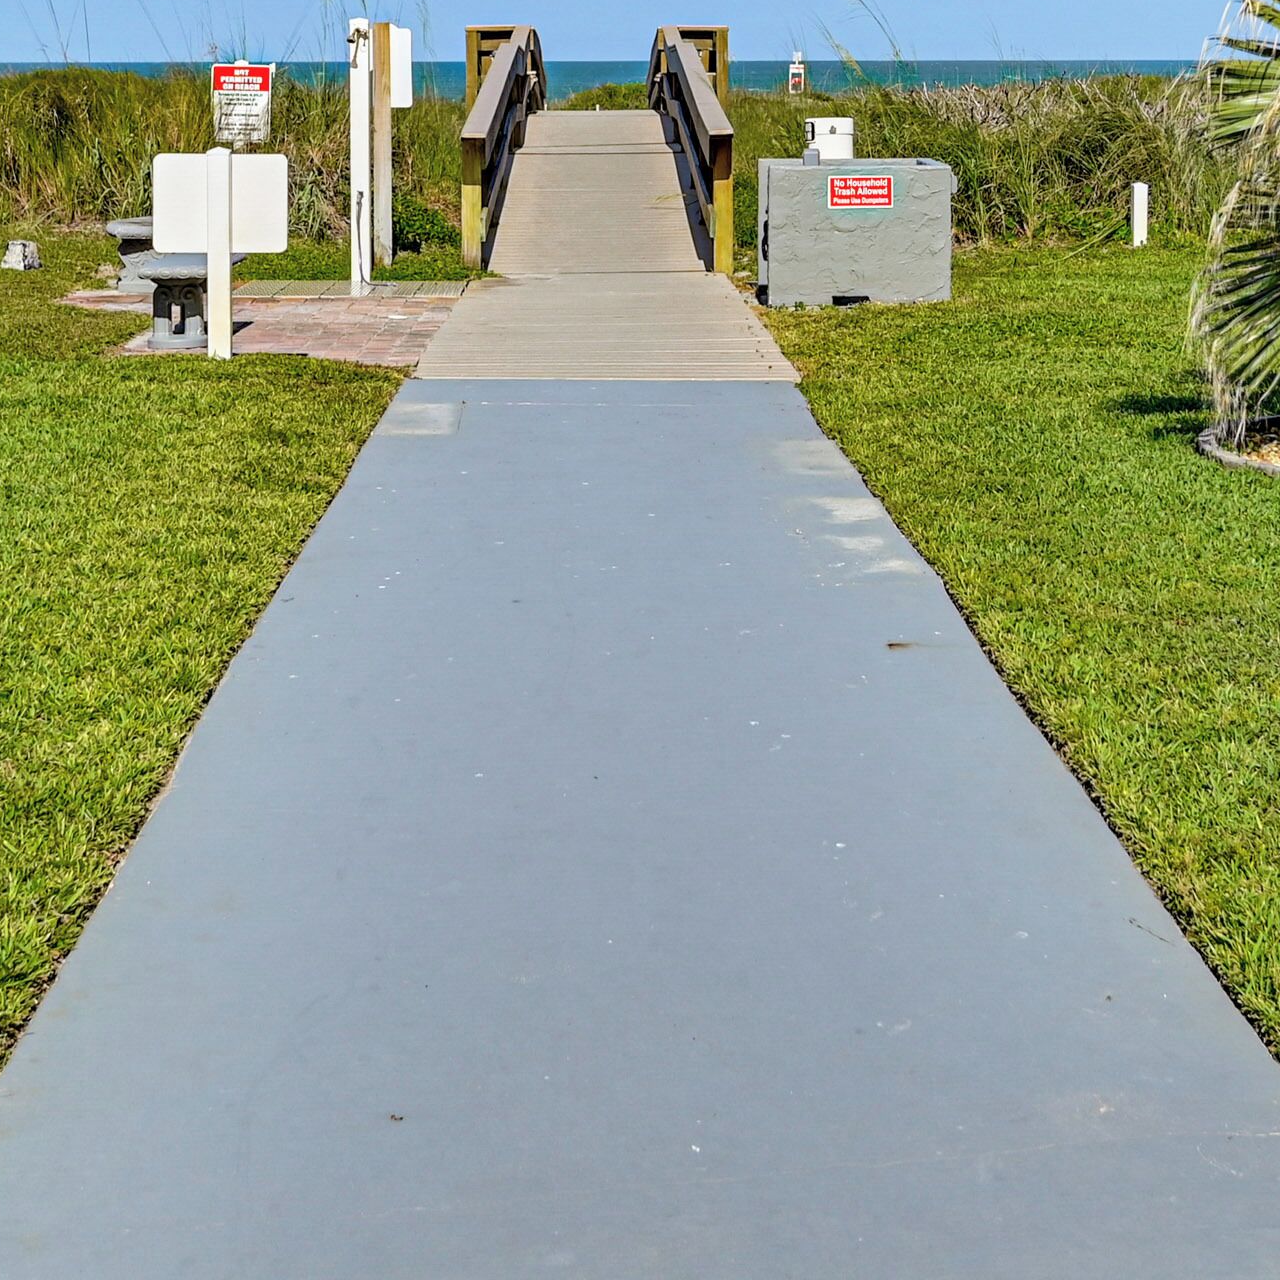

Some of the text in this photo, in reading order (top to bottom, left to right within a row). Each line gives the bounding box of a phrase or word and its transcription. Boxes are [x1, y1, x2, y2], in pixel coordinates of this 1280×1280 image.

[220, 76, 263, 84] PERMITTED
[833, 178, 888, 187] No Household
[834, 187, 888, 195] Trash Allowed
